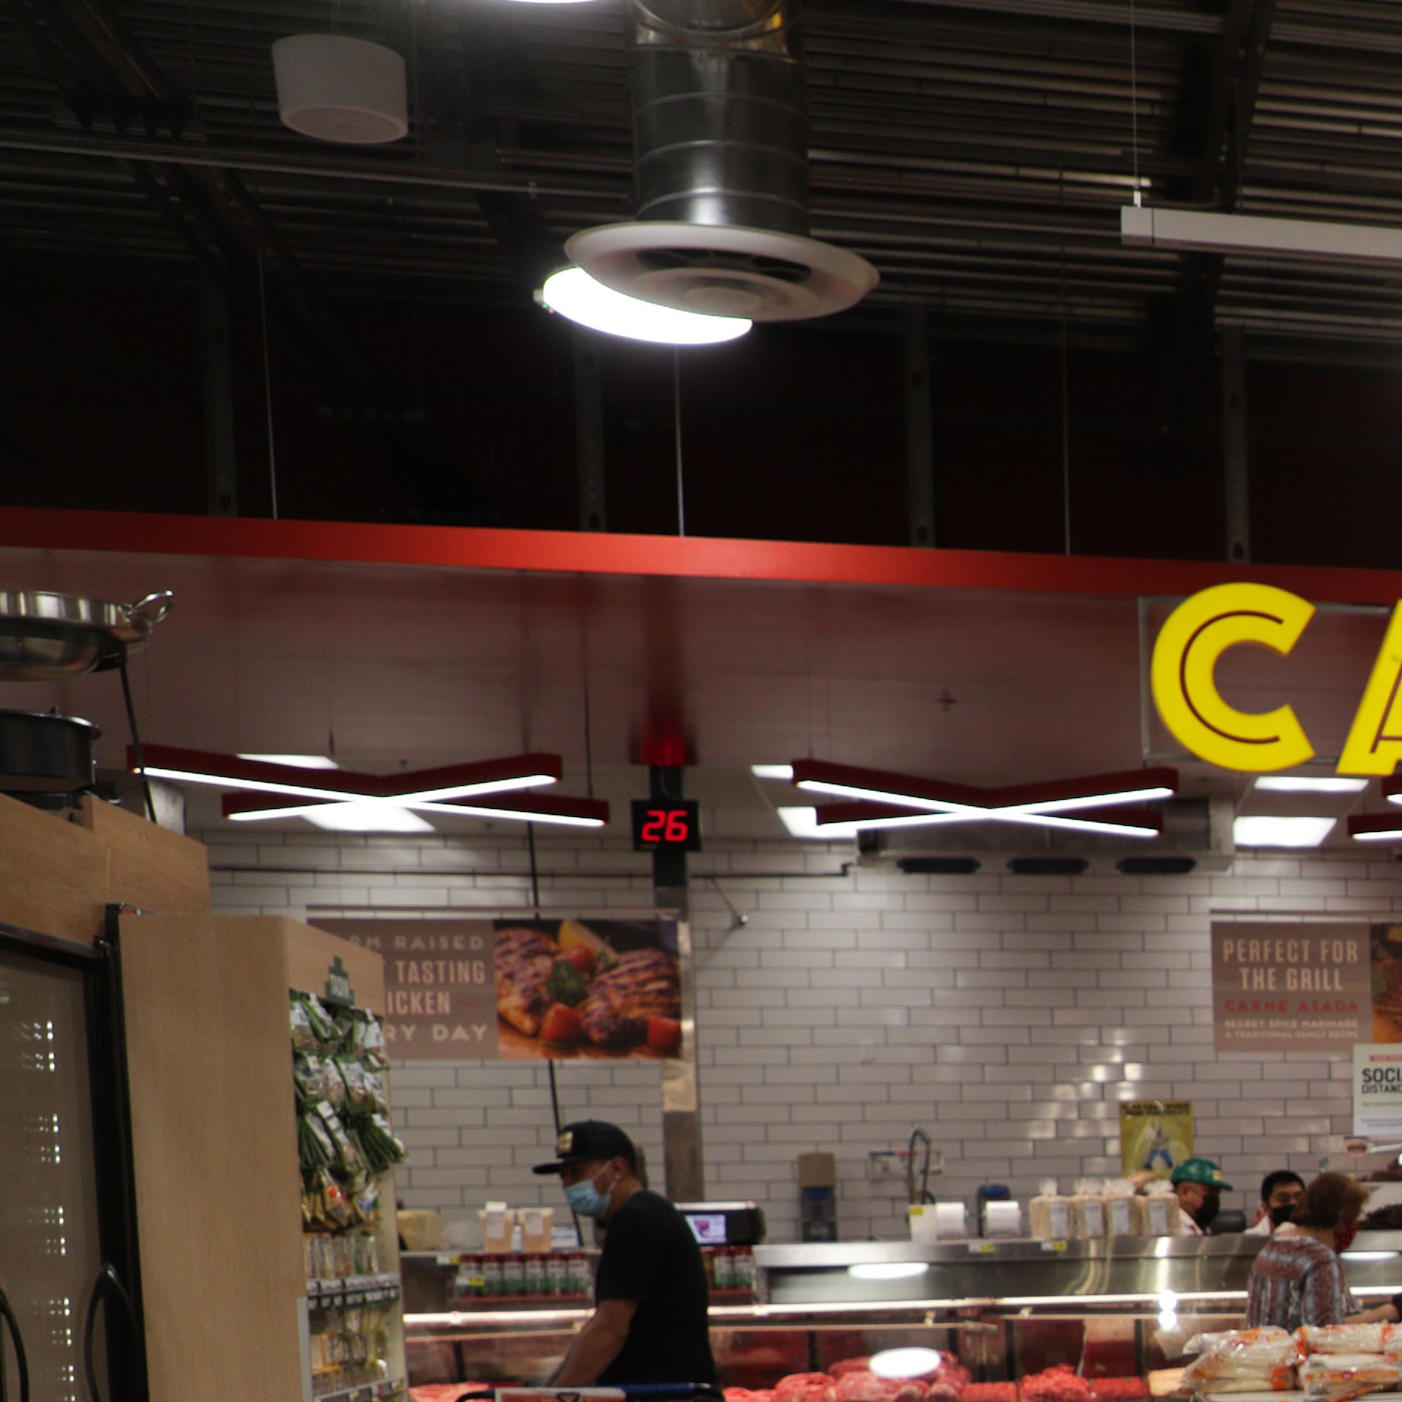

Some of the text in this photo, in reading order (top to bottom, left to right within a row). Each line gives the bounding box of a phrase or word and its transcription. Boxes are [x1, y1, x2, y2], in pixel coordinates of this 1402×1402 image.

[641, 809, 688, 842] 26
[395, 935, 484, 949] RAISED
[1223, 939, 1358, 962] PERFECT FOR
[396, 960, 486, 984] TASTING
[1240, 968, 1343, 991] THE GRILL
[388, 991, 450, 1015] ICKEN
[433, 1024, 488, 1041] DAY
